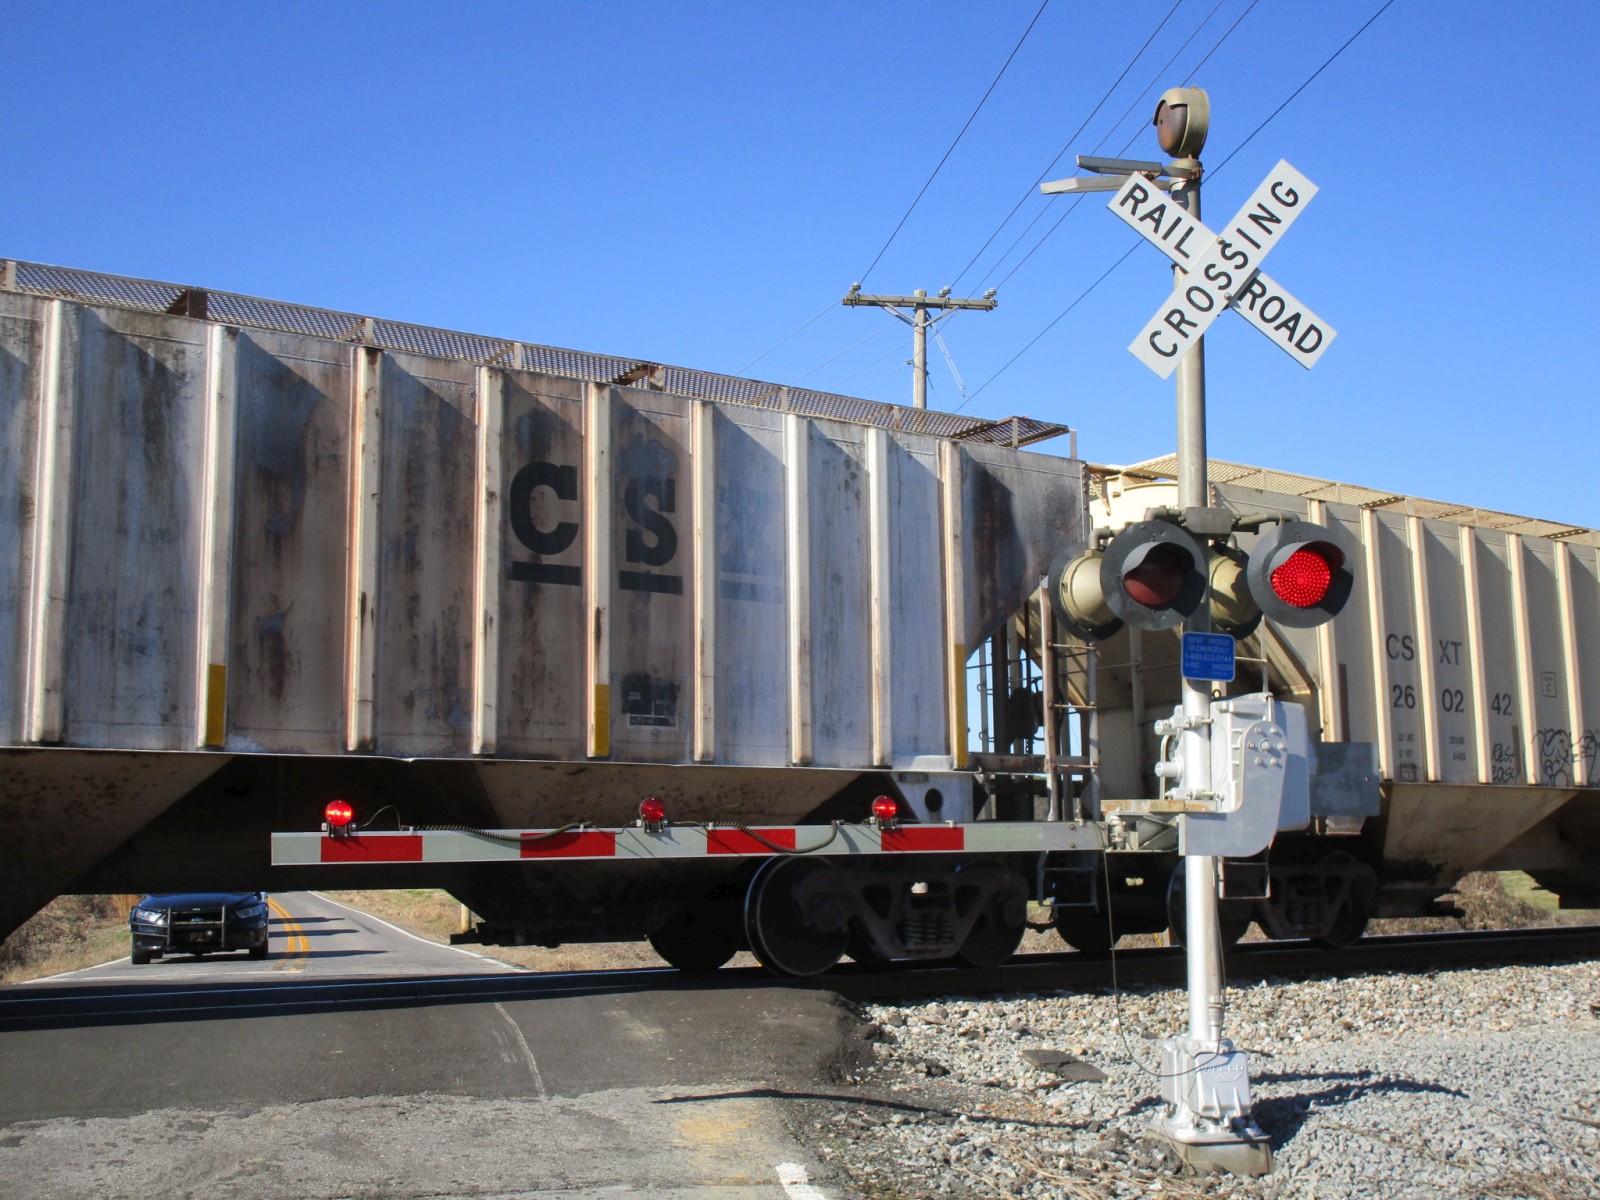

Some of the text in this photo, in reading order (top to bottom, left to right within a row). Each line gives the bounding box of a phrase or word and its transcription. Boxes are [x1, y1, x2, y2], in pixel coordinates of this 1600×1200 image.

[1119, 182, 1323, 354] RAIL ROAD
[1149, 181, 1300, 358] CROSSING
[1196, 645, 1230, 654] EMERGENCY
